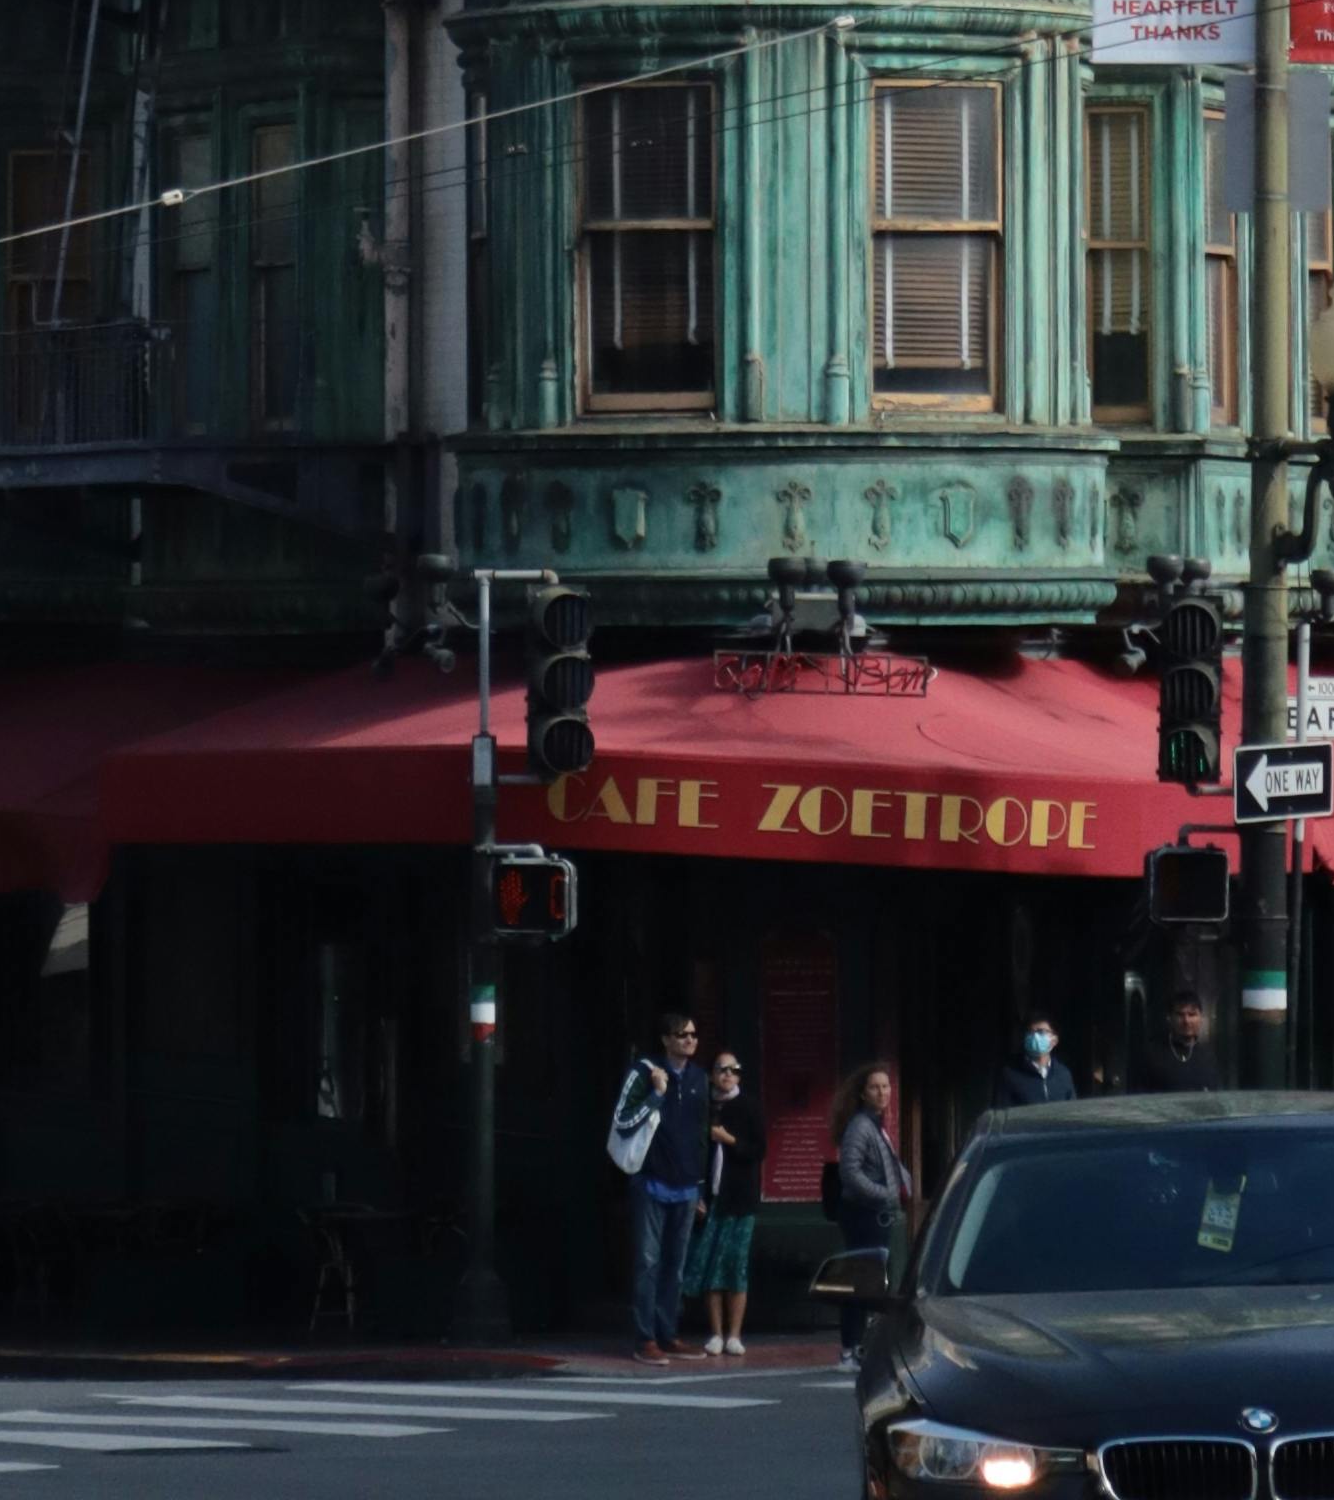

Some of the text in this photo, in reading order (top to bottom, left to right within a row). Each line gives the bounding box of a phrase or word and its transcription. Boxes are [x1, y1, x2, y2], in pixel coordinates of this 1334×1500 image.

[1112, 0, 1239, 16] HEARTFELT
[1130, 24, 1222, 41] THANKS
[1266, 767, 1320, 793] ONE WAY
[547, 773, 1097, 850] CAFE ZOETROPE
